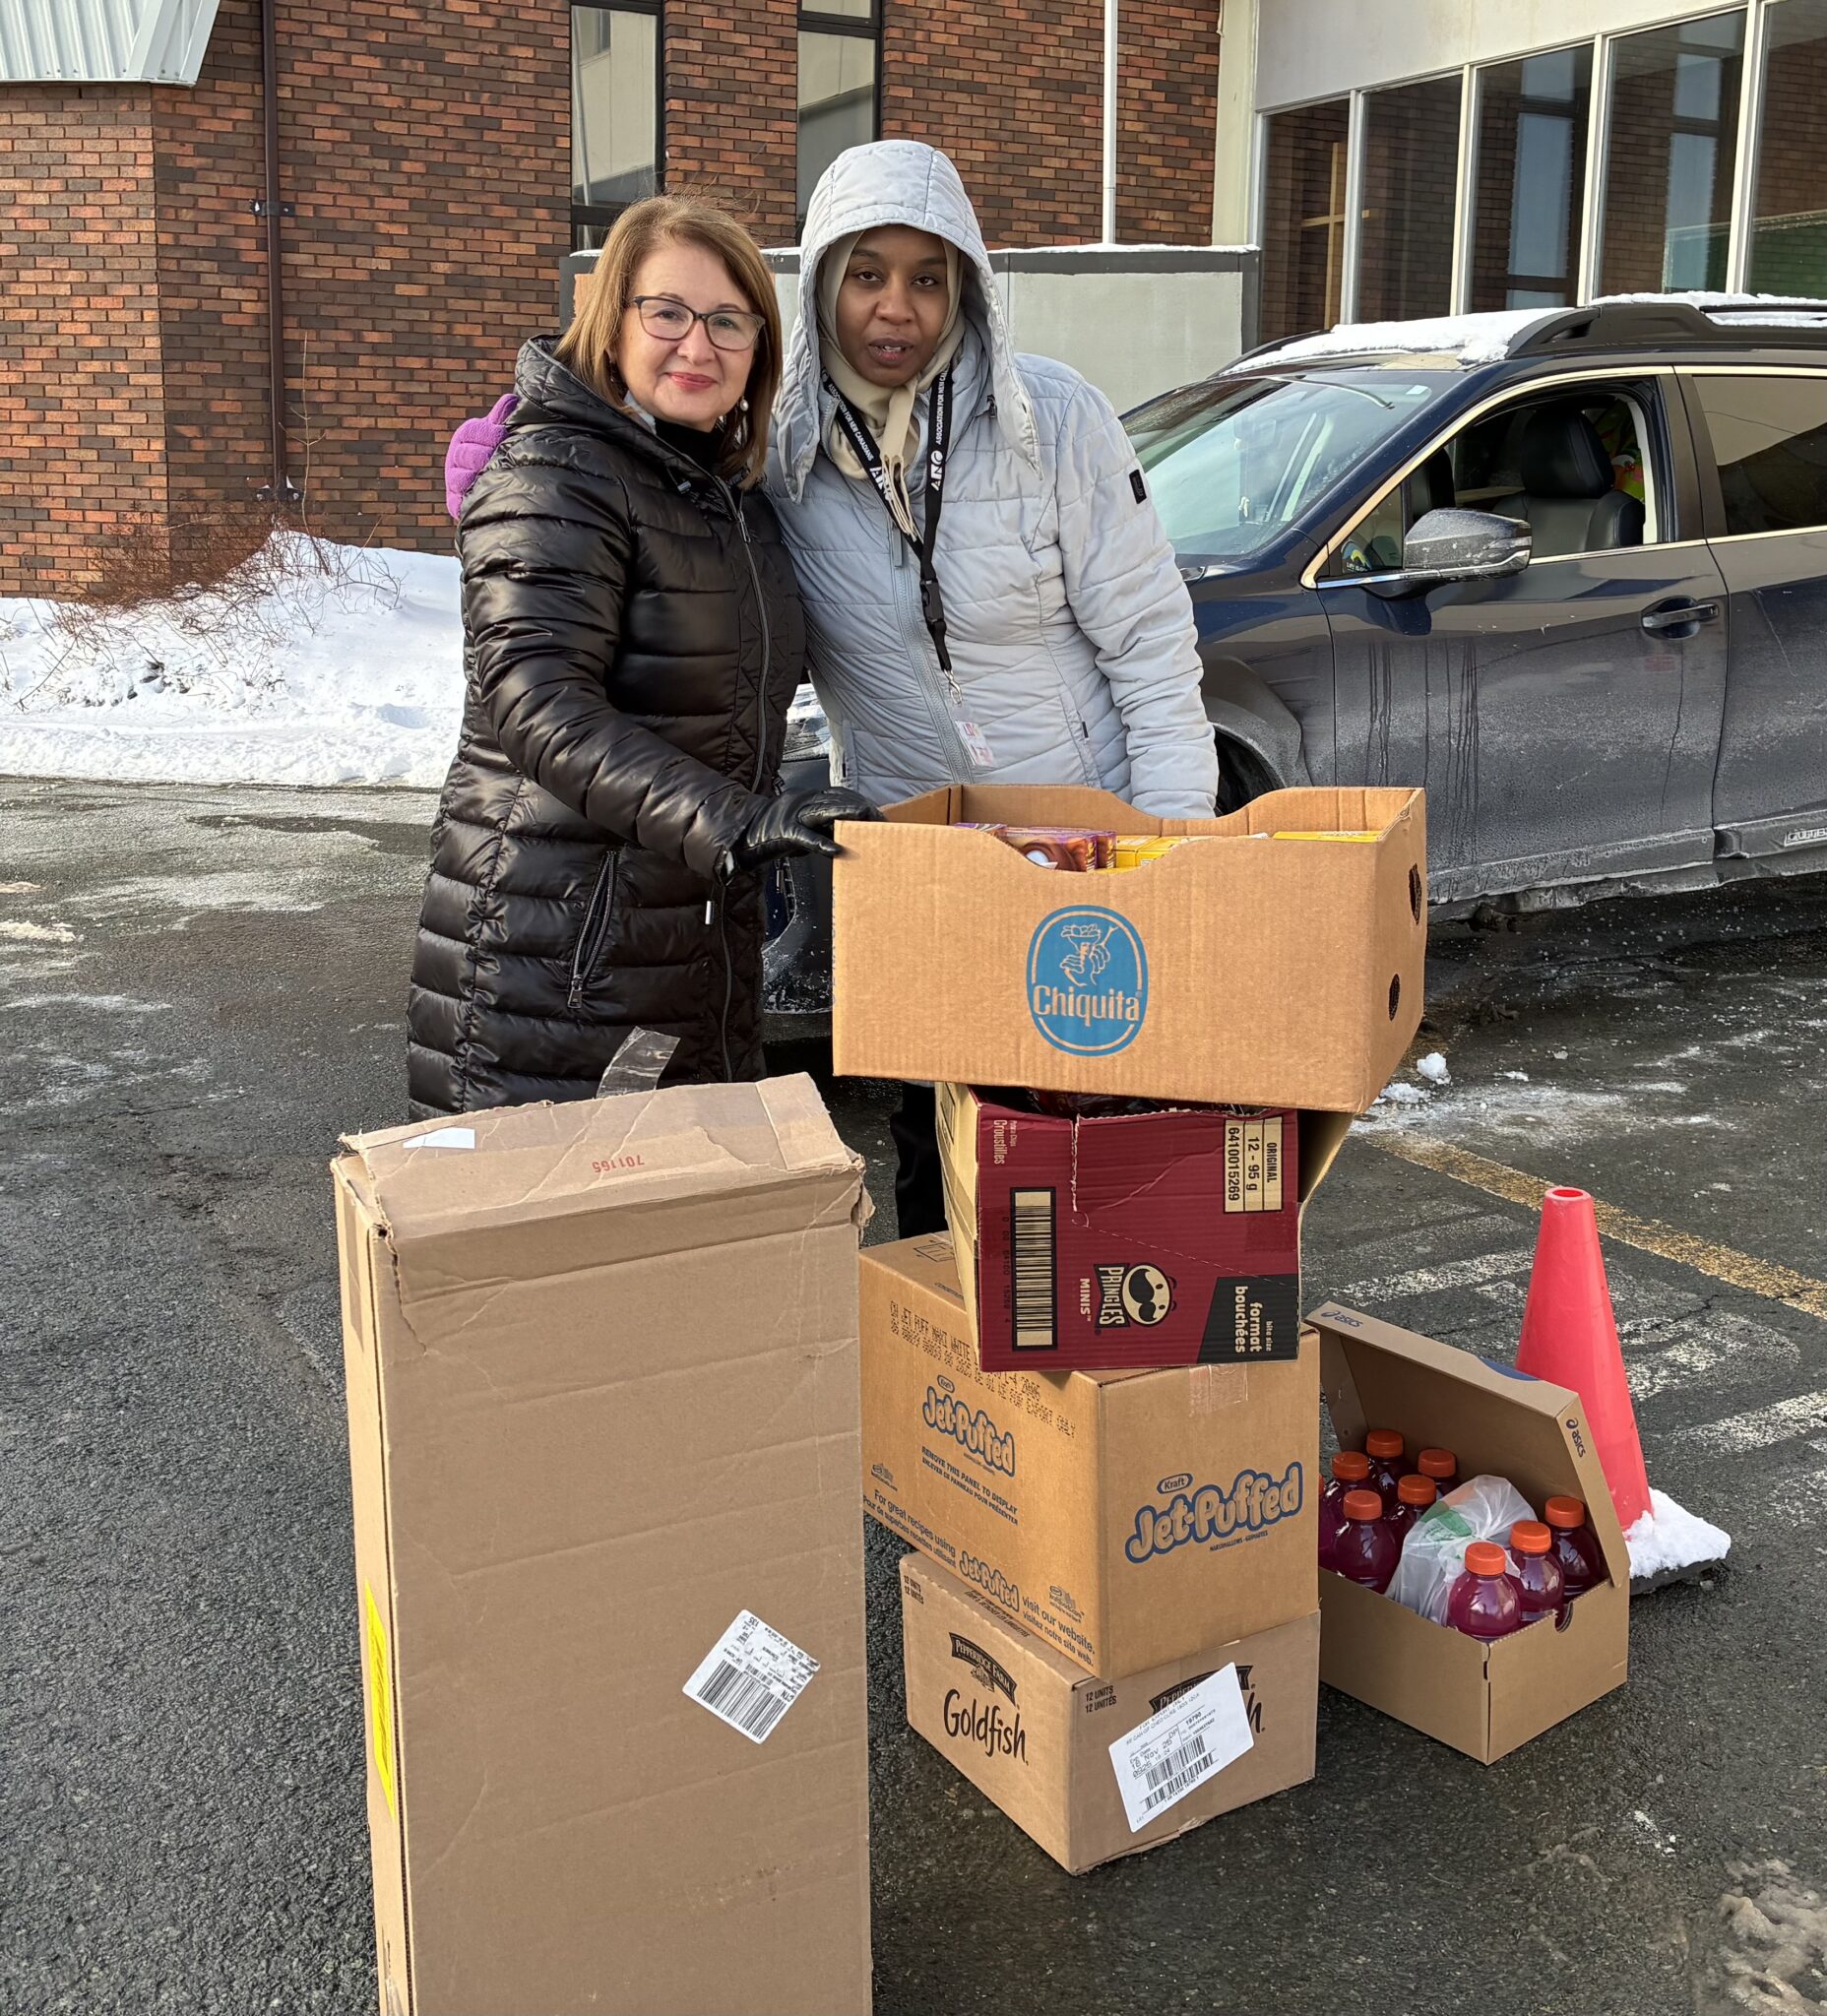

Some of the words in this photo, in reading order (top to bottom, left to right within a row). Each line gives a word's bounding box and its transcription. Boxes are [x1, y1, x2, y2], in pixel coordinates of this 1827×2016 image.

[936, 407, 944, 444] ASSOCIATION
[1034, 985, 1140, 1027] Chiquita
[993, 1119, 1008, 1164] Croustilles
[1248, 1137, 1259, 1151] 12
[1266, 1142, 1277, 1183] ORIGINAL
[592, 1155, 645, 1173] 701165
[1228, 1127, 1240, 1201] 6410015269
[1248, 1164, 1259, 1179] 95
[1099, 1267, 1125, 1324] PRINGLES
[1235, 1286, 1248, 1352] bouchées
[1250, 1302, 1263, 1352] format
[1335, 1315, 1363, 1327] asics
[1572, 1430, 1586, 1457] asics
[922, 1446, 946, 1468] REMOVE
[947, 1462, 960, 1477] THIS
[961, 1472, 981, 1491] PANEL
[982, 1485, 990, 1497] TO
[992, 1492, 1018, 1514] DISPLAY
[1164, 1477, 1185, 1490] Kraft
[1125, 1462, 1303, 1563] Jet-Puffed
[875, 1489, 886, 1505] For
[888, 1502, 906, 1521] great
[907, 1515, 933, 1540] recipes
[935, 1535, 956, 1558] using
[1022, 1597, 1040, 1615] visit
[1042, 1611, 1056, 1625] our
[1058, 1621, 1095, 1655] website.
[910, 1579, 921, 1592] UNITS
[1023, 1611, 1043, 1629] visitez
[1044, 1627, 1062, 1644] notre
[1063, 1641, 1075, 1653] site
[1077, 1650, 1093, 1667] web.
[956, 1639, 992, 1672] PEPPERIDGE
[993, 1665, 1010, 1692] FARM
[1085, 1704, 1093, 1713] 12
[1094, 1695, 1117, 1710] UNITÉS
[1086, 1692, 1093, 1701] 12
[1094, 1685, 1114, 1699] UNITS
[944, 1689, 1025, 1763] Goldfish
